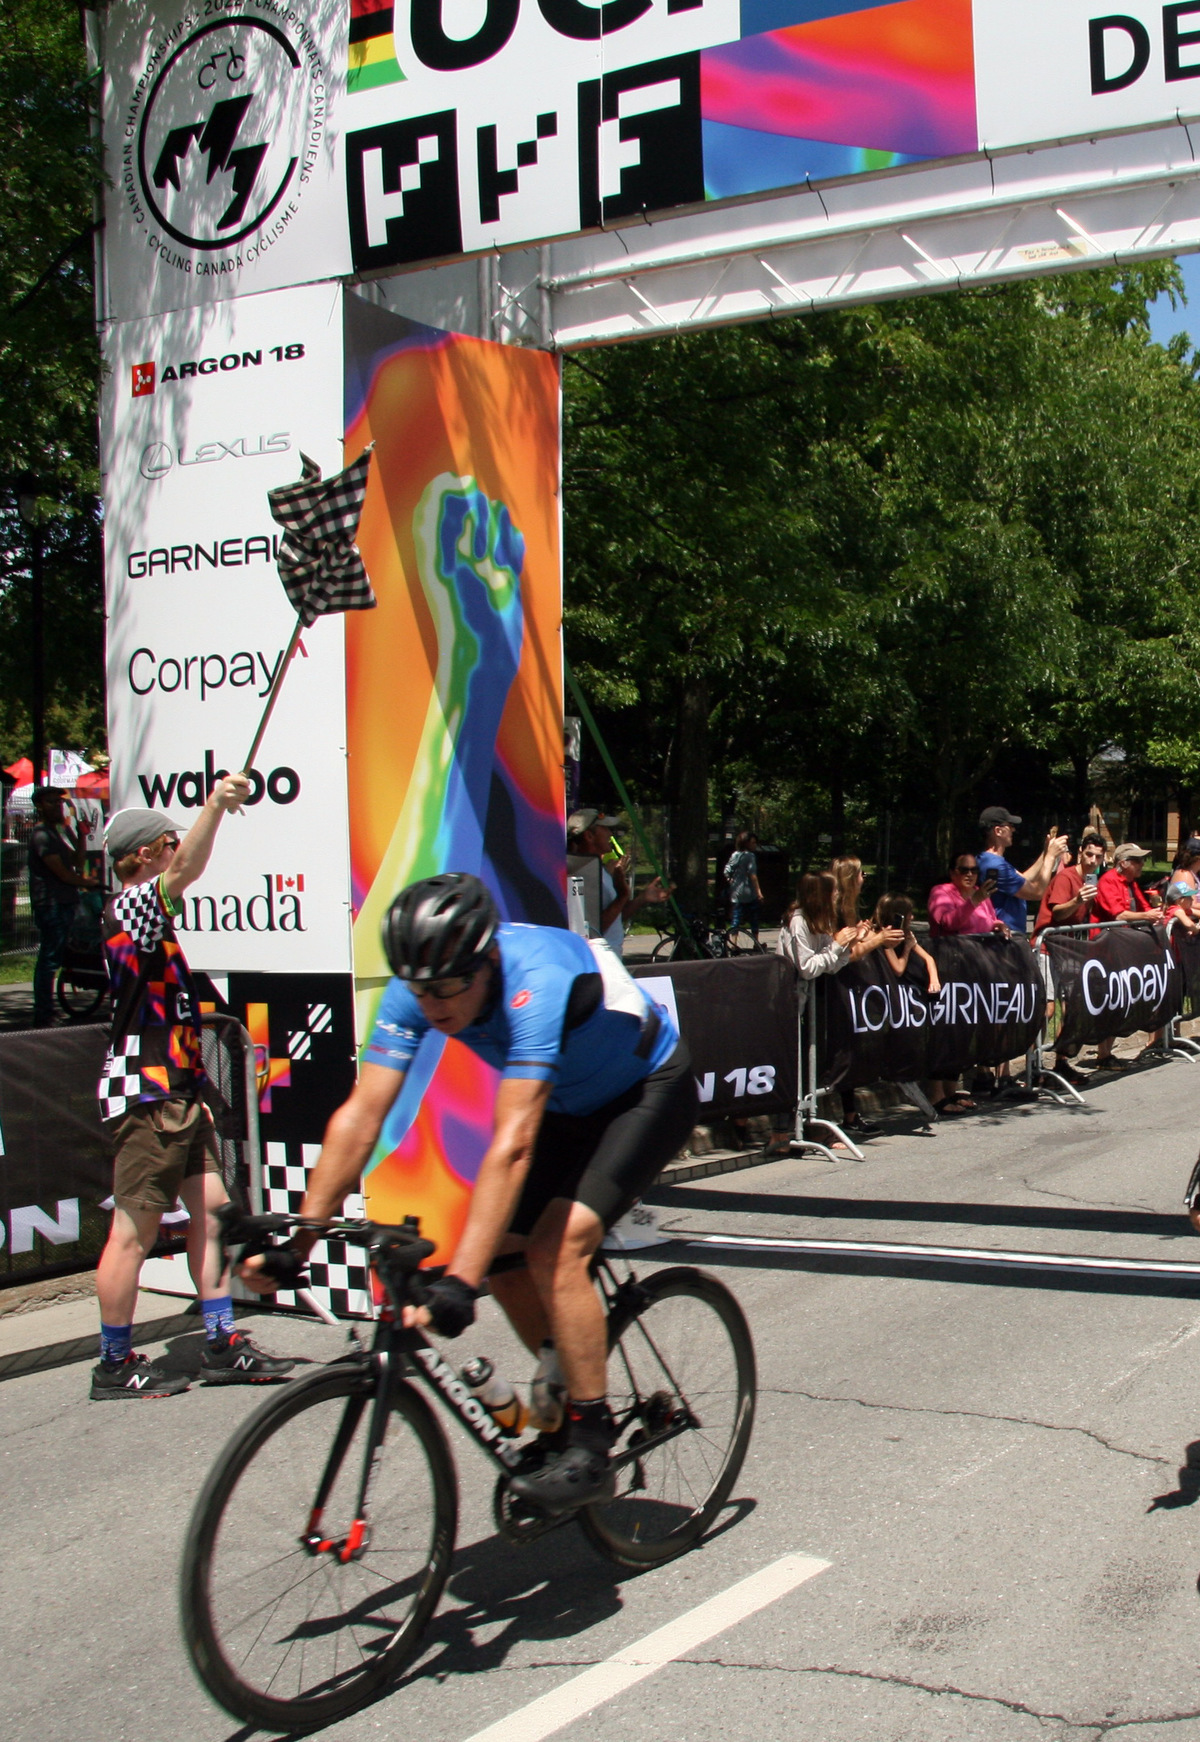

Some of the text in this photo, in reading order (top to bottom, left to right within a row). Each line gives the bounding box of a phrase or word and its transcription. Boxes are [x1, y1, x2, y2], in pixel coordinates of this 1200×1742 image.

[255, 0, 323, 79] CHAMPIONNATS
[125, 17, 195, 137] CHAMPIONSHIPS
[300, 84, 325, 184] CANADIENS
[123, 144, 145, 224] CANADIAN
[149, 204, 299, 275] CYCLING CANADA CYCLISME
[161, 344, 305, 383] ARGON 18
[178, 432, 291, 466] LEXUS
[128, 648, 285, 701] Corpay
[173, 874, 308, 932] anada
[849, 984, 927, 1033] LOUIS
[1082, 958, 1168, 1019] Corpay
[724, 1065, 775, 1098] 18
[415, 1348, 502, 1441] ARGON
